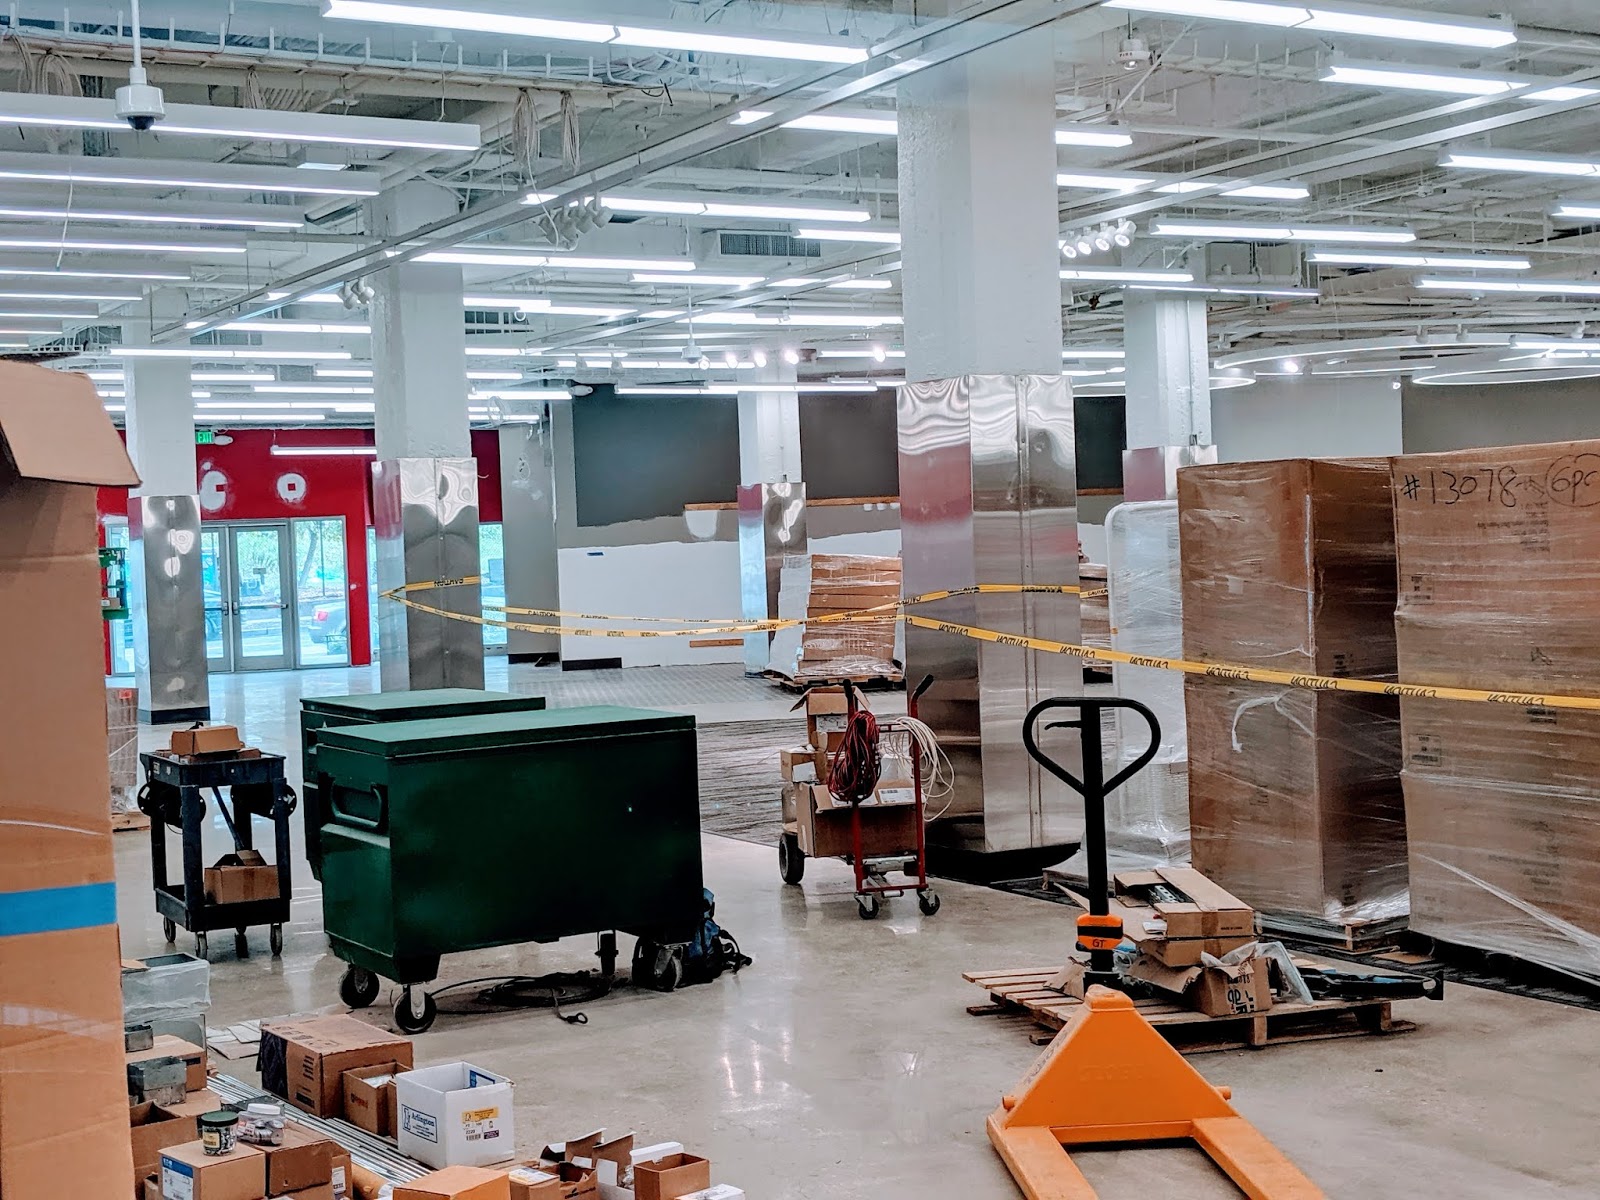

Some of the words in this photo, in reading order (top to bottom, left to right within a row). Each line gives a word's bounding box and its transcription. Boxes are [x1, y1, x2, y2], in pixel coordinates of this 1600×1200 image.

[198, 432, 212, 443] EXIT
[1092, 938, 1106, 948] GT
[412, 1112, 435, 1127] Arlington
